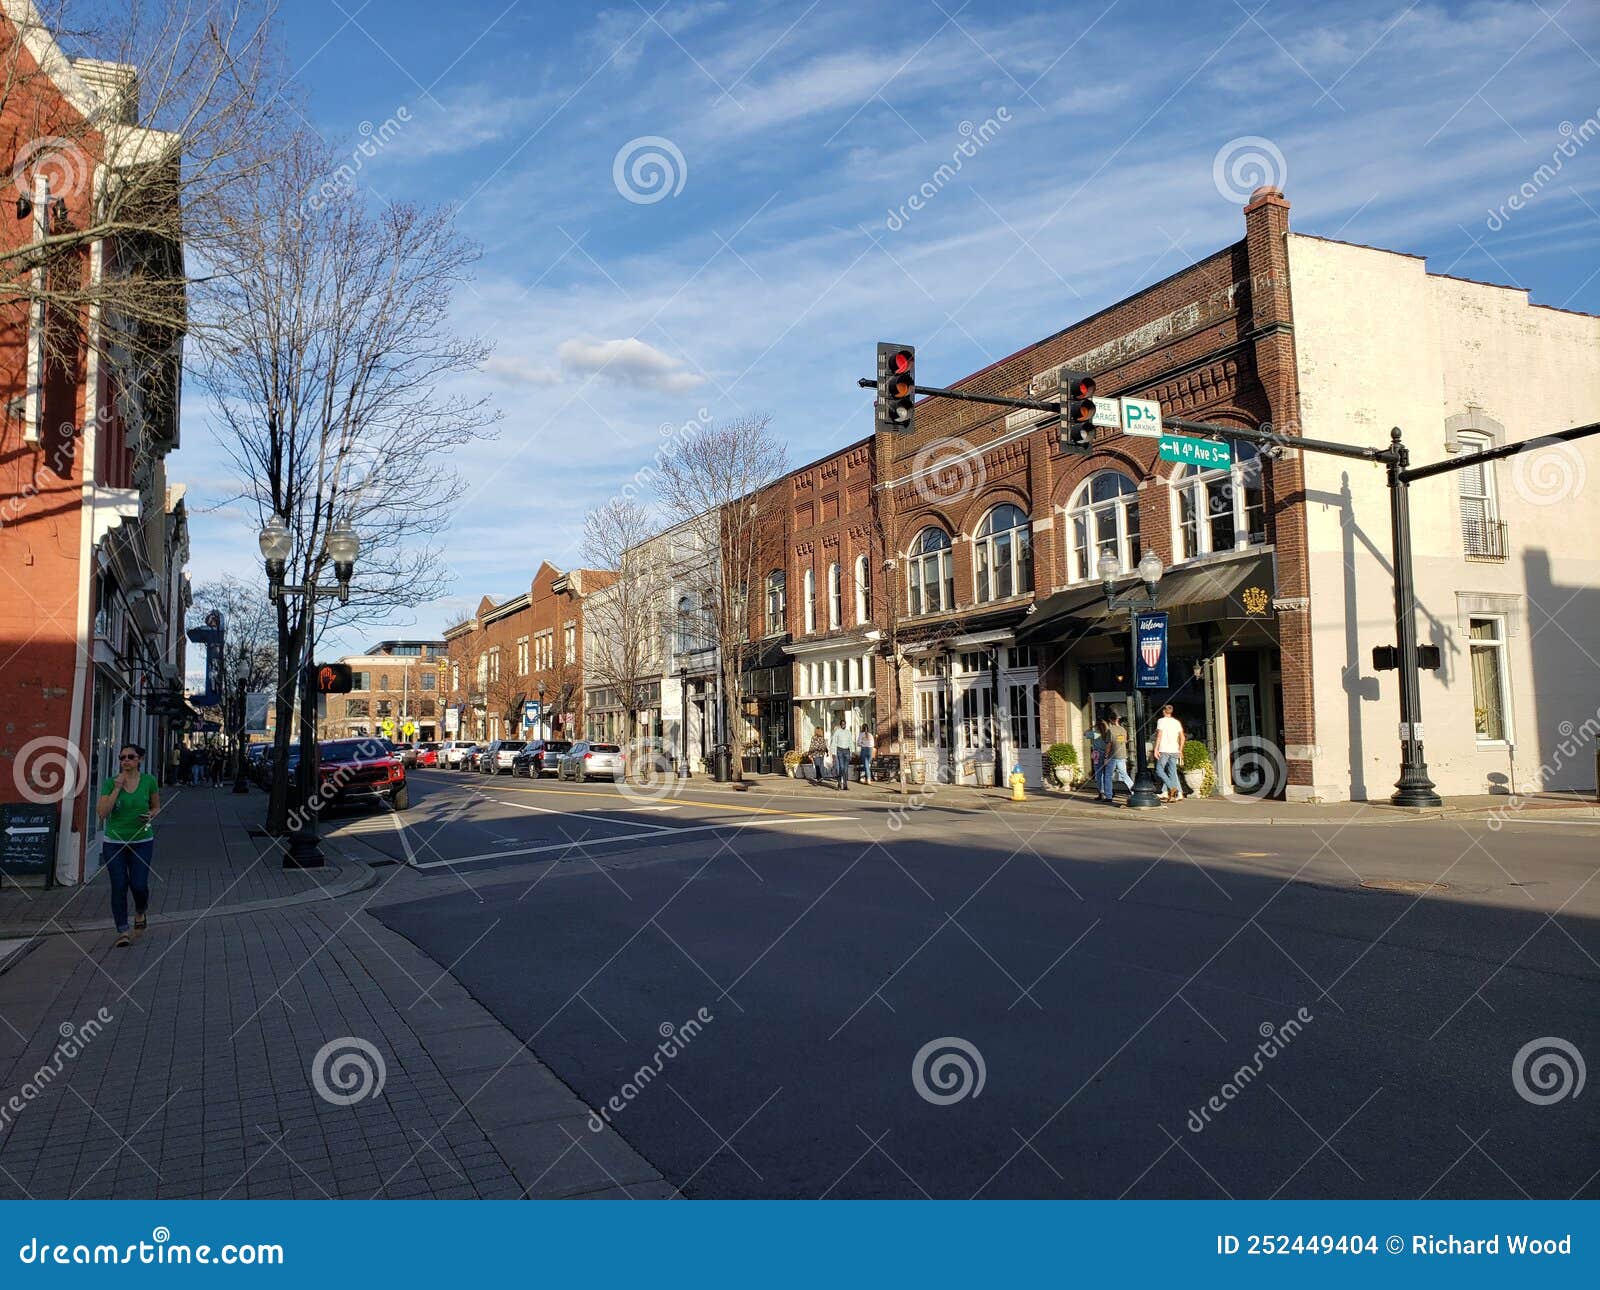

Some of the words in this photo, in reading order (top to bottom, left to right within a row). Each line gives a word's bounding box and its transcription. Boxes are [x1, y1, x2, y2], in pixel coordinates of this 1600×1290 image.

[1095, 411, 1117, 423] ARAGE
[1172, 441, 1180, 456] N
[1194, 445, 1210, 461] Ave
[1212, 447, 1219, 462] S
[1140, 619, 1165, 631] Welcome
